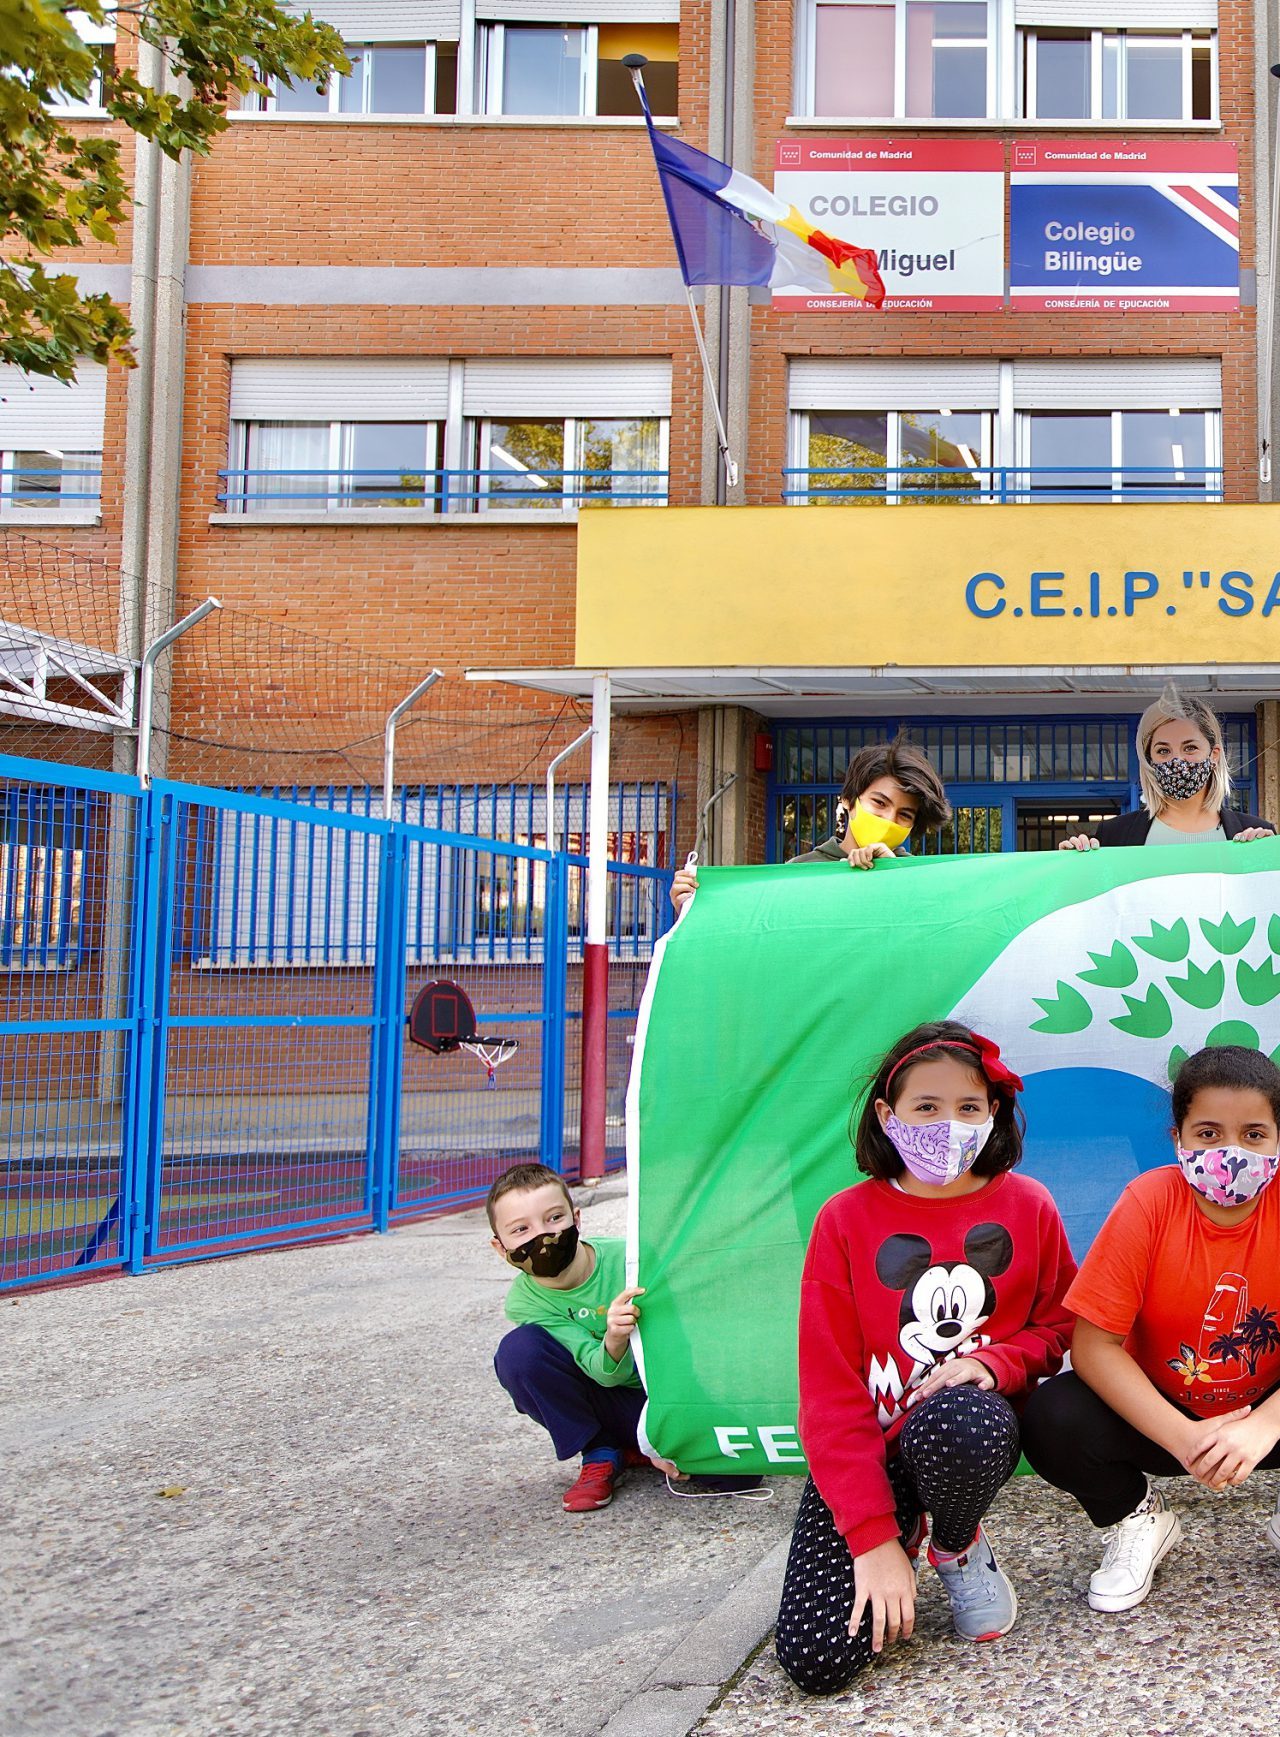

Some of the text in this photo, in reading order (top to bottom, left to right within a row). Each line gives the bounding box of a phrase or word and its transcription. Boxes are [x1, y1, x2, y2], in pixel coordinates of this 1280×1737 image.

[809, 150, 912, 159] Comunidad de Madrid
[1044, 151, 1147, 160] Comunidad de Madrid
[809, 195, 939, 216] COLEGIO
[1045, 222, 1135, 245] Colegio
[1045, 251, 1142, 276] Bilingüe
[807, 298, 862, 308] CONSEJERÍA
[881, 298, 933, 308] EDUCACIÓN
[1044, 299, 1170, 309] CONSEJERÍA DE EDUCACIÓN
